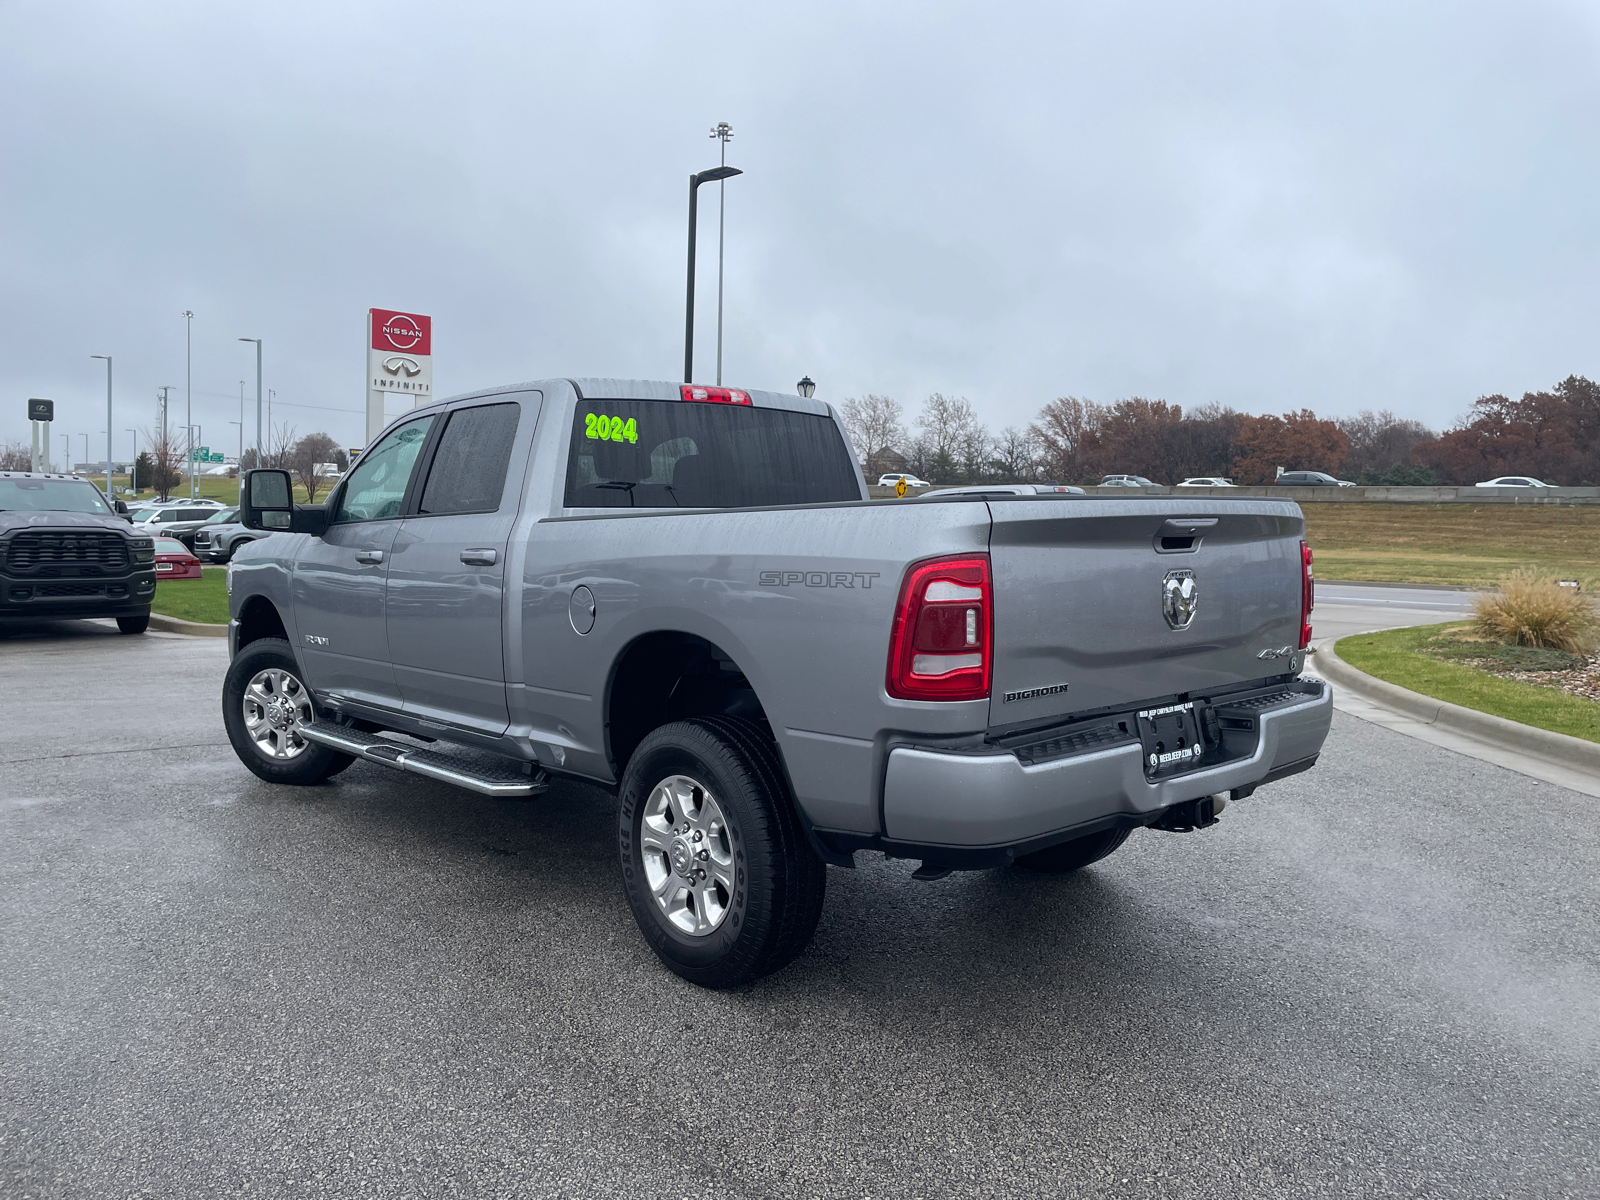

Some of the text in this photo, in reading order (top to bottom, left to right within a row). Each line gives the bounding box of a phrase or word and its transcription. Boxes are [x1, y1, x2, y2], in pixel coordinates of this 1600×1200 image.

[382, 326, 422, 338] NISSAN
[374, 378, 429, 392] INFINITI
[585, 412, 638, 444] 2024
[759, 571, 881, 589] SPORT
[304, 634, 330, 646] RAM
[1004, 683, 1069, 702] BIGHORN
